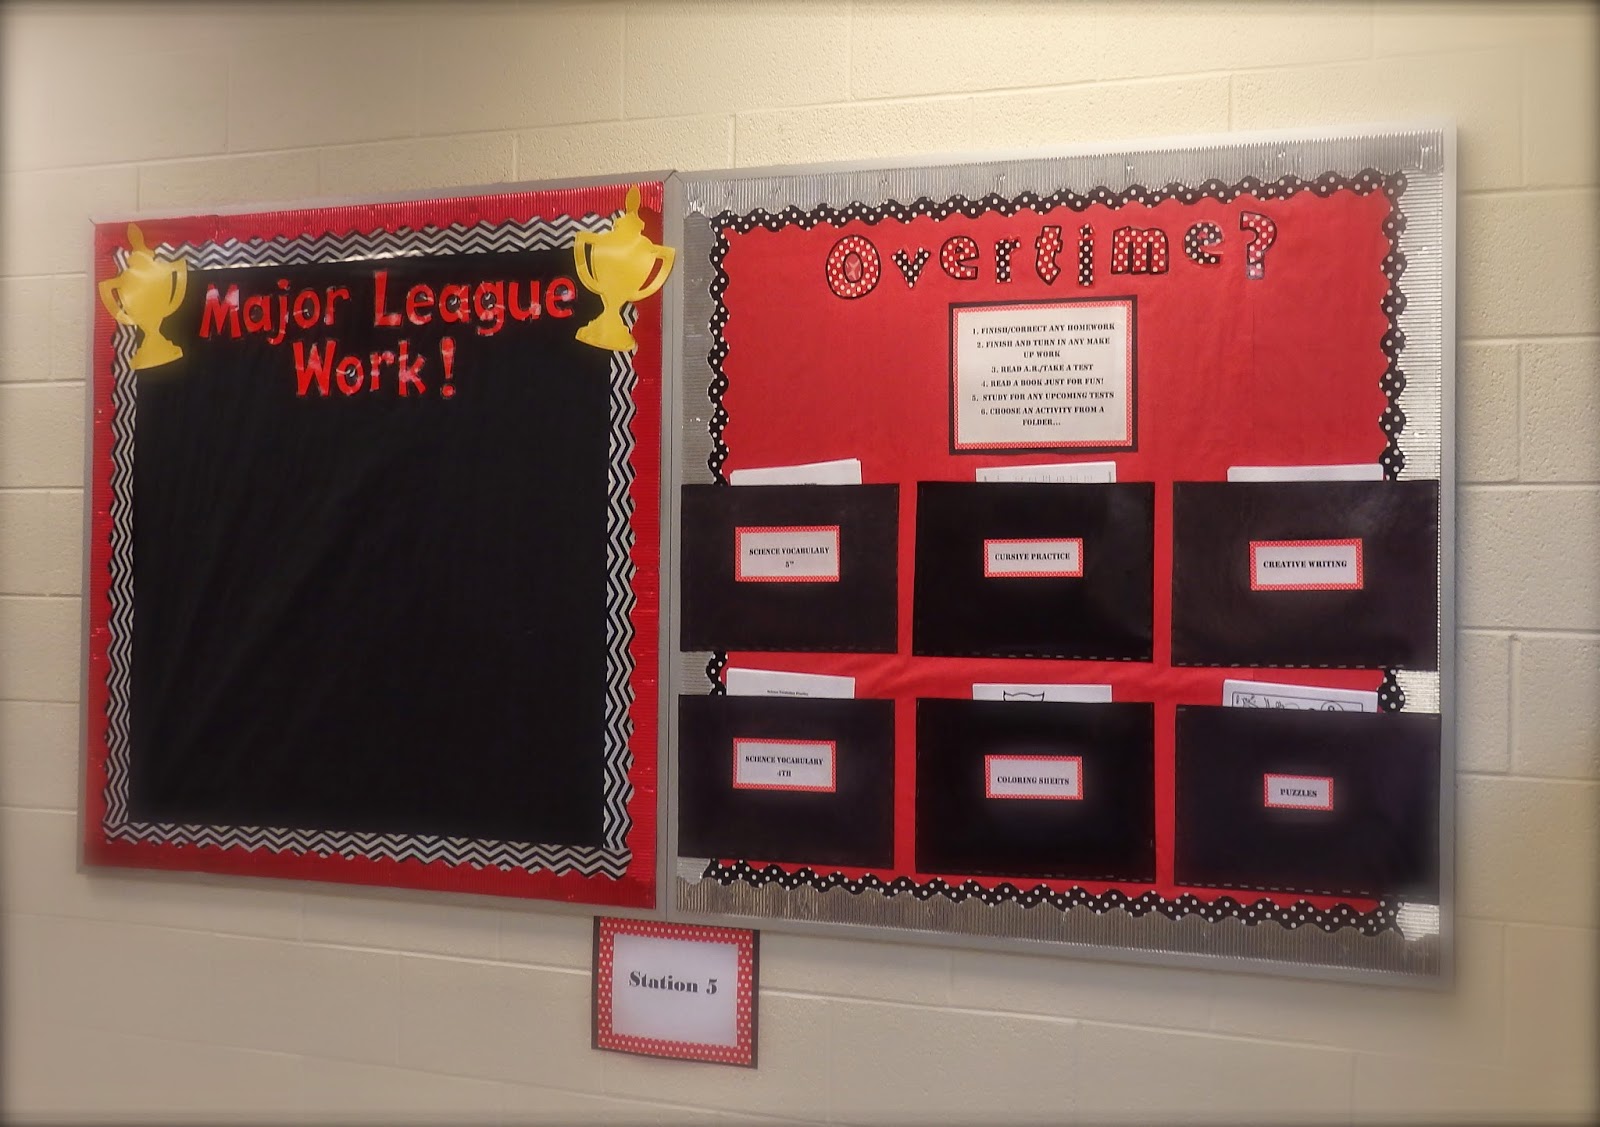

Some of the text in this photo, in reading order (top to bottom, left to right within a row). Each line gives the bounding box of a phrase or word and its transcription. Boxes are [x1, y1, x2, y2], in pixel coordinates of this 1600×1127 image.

[825, 210, 1278, 300] Overtime?
[199, 269, 578, 346] Major League
[981, 325, 1048, 335] FINISH/CORRECT
[1048, 324, 1066, 332] ANY
[1067, 322, 1115, 331] HOMEWORK
[976, 341, 984, 349] 2.
[985, 340, 1013, 348] FINISH
[1014, 339, 1032, 347] AND
[1032, 338, 1055, 346] TURN
[1067, 338, 1085, 346] ANY
[1086, 337, 1111, 345] MAKE
[1036, 350, 1060, 358] WORK
[1000, 365, 1022, 373] READ
[1072, 363, 1094, 371] TEST
[990, 379, 1012, 387] READ
[1020, 378, 1043, 386] BOOK
[1044, 378, 1065, 386] JUST
[1084, 377, 1104, 385] FUN!
[982, 393, 1008, 401] STUDY
[1009, 393, 1026, 401] FOR
[1027, 392, 1044, 400] ANY
[1044, 392, 1088, 400] UPCOMING
[1089, 391, 1115, 399] TESTS
[989, 407, 1021, 416] CHOOSE
[1035, 406, 1072, 414] ACTIVITY
[1073, 405, 1098, 413] FROM
[1098, 405, 1105, 413] A
[748, 546, 830, 556] SCIENCE VOCABULARY
[994, 552, 1071, 561] CURSIVE PRACTICE
[1263, 560, 1348, 569] CREATIVE WRITING
[745, 755, 824, 766] SCIENCE VOCABULARY
[997, 775, 1070, 786] COLORING SHEETS
[1280, 788, 1318, 798] PUZZLES
[629, 970, 718, 995] Station 5
